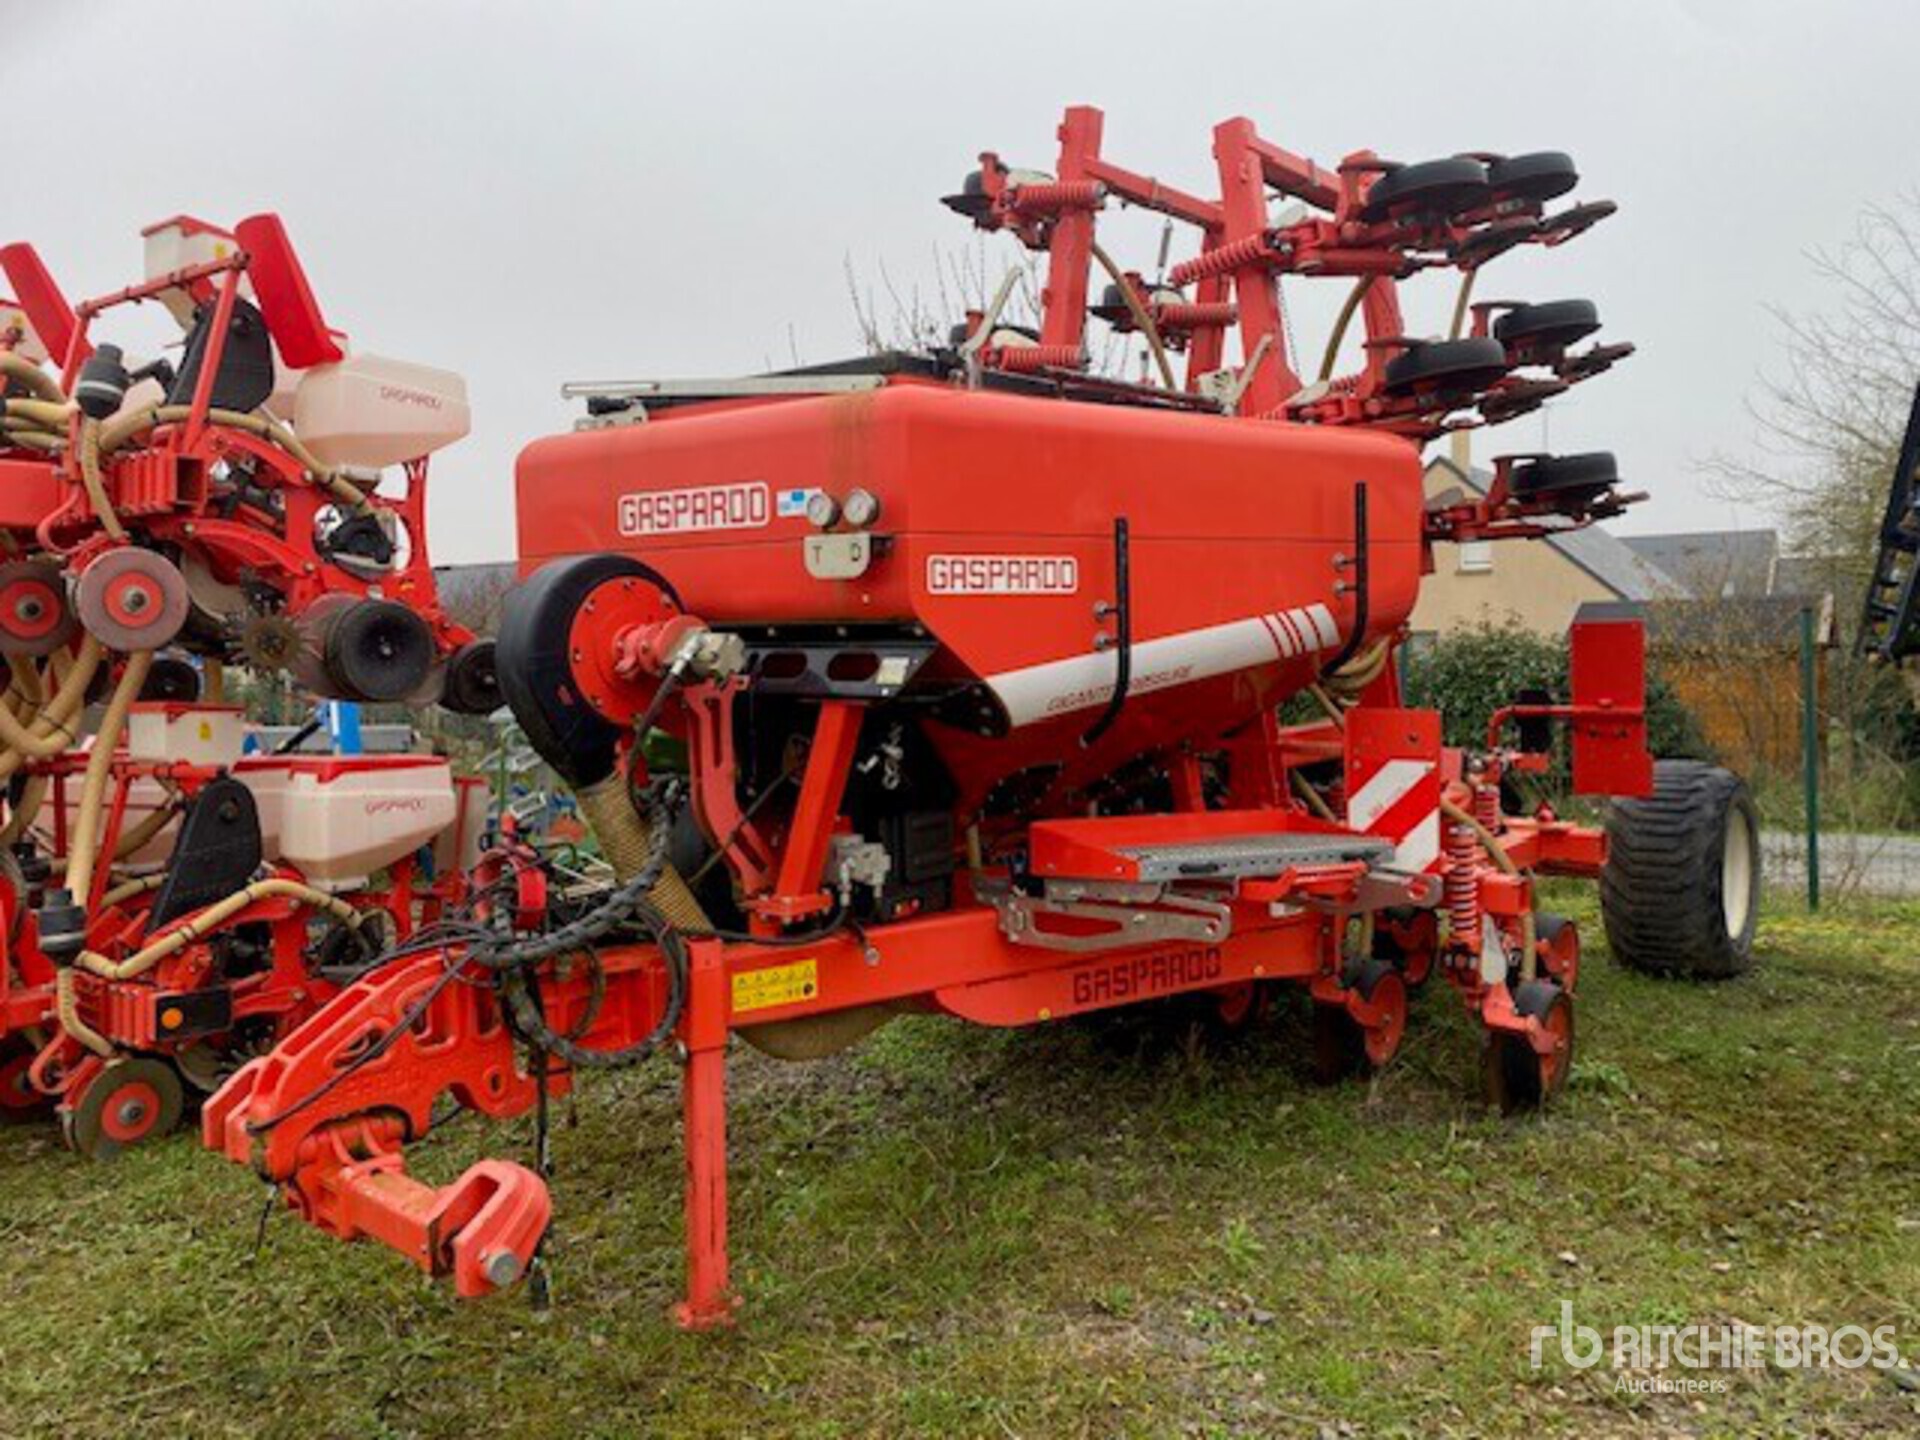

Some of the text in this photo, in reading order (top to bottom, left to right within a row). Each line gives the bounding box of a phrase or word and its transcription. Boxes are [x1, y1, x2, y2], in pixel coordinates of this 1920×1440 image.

[622, 487, 766, 532] GASPARDO
[931, 558, 1075, 590] GASPARDO
[1073, 947, 1222, 1004] GASPARDO
